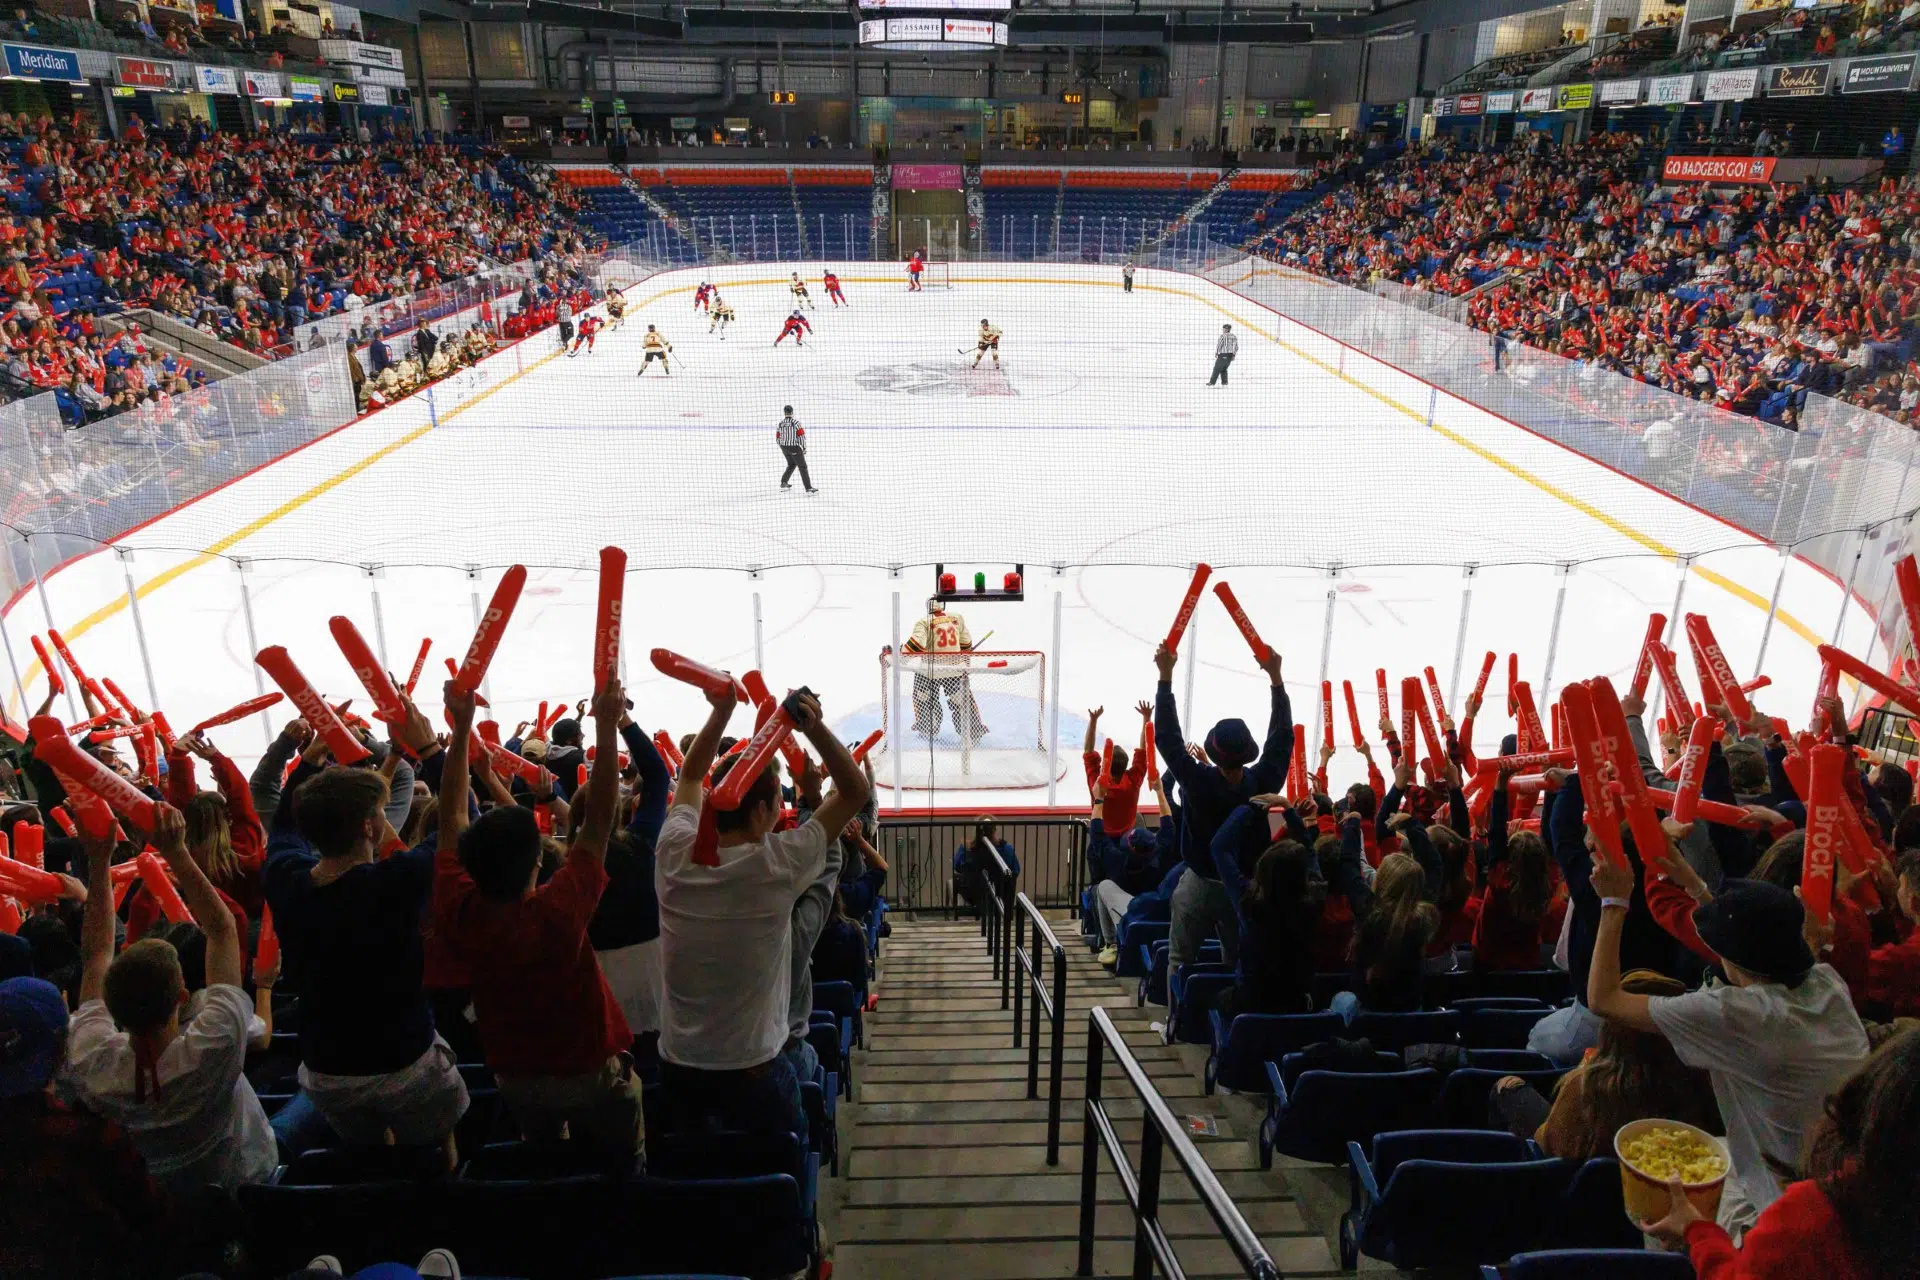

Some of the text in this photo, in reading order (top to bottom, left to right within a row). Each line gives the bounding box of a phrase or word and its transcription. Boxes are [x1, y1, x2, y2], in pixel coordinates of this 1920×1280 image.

[18, 50, 69, 71] Meridian
[1860, 63, 1911, 75] MOUNTAINVIEW
[1778, 67, 1819, 88] Rinaldi
[774, 92, 794, 103] 0 0
[1064, 94, 1081, 103] 4:11
[966, 176, 980, 185] GO
[1666, 160, 1748, 178] GO BADGERS GO!
[1175, 594, 1198, 632] Brock
[1234, 606, 1258, 641] Brock
[462, 607, 503, 671] Brock
[936, 626, 957, 648] 33
[1705, 644, 1738, 690] Brock
[354, 667, 397, 720] Brock
[1378, 687, 1388, 717] Brock
[1430, 684, 1445, 712] Brock
[295, 688, 340, 736] Brock
[1322, 700, 1333, 728] Brock
[114, 725, 143, 738] Brock
[1402, 709, 1414, 748] Brock
[1528, 711, 1545, 747] Brock
[1509, 753, 1550, 764] Brock
[1680, 744, 1704, 789] Brock
[89, 768, 140, 811] Brock
[1590, 740, 1616, 817] Brock
[1809, 805, 1840, 879] Brock
